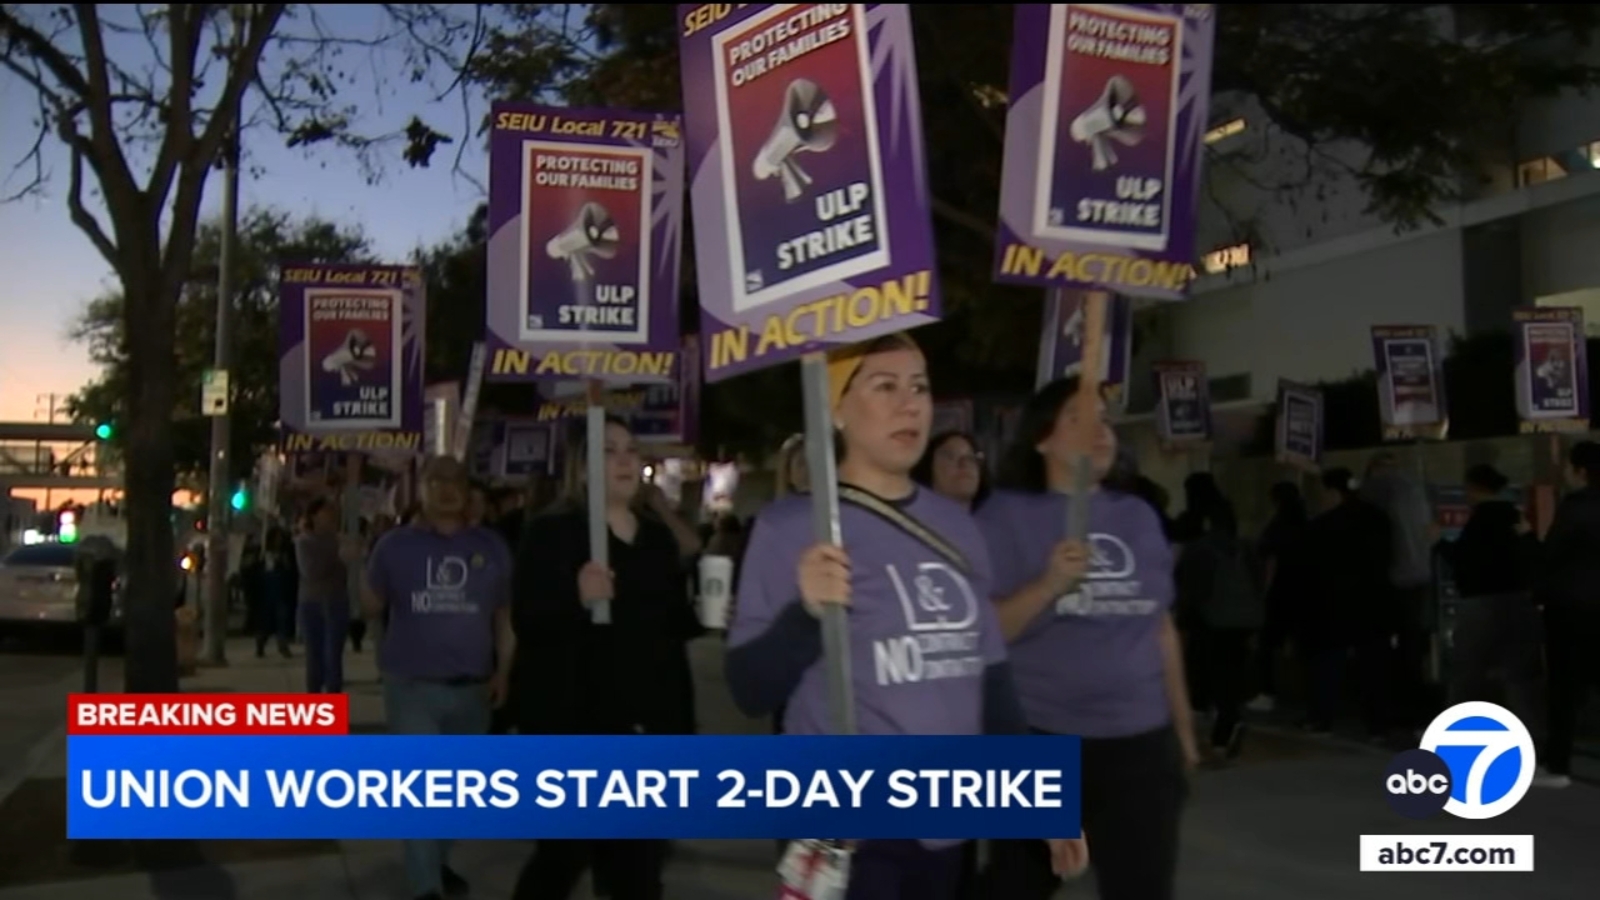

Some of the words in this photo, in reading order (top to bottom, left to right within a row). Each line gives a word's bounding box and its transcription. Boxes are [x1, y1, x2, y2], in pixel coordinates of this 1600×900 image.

[730, 4, 848, 66] PROTECTING
[1068, 12, 1170, 46] PROTECTING
[732, 56, 768, 87] OUR
[766, 19, 850, 70] FAMILIES
[1068, 35, 1098, 54] OUR
[1098, 39, 1170, 66] FAMILIES
[496, 112, 547, 131] SEIU
[550, 117, 606, 137] Local
[610, 121, 647, 139] 721
[535, 155, 638, 175] PROTECTING
[535, 173, 568, 187] OUR
[570, 174, 638, 190] FAMILIES
[1115, 175, 1162, 200] ULP
[815, 182, 869, 222] ULP
[1077, 198, 1161, 227] STRIKE
[778, 215, 874, 271] STRIKE
[282, 268, 320, 284] SEIU
[325, 269, 366, 285] Local
[371, 270, 397, 285] 721
[1001, 243, 1043, 277] IN
[1047, 253, 1194, 291] ACTION!
[312, 298, 389, 311] PROTECTING
[596, 285, 635, 304] ULP
[313, 309, 337, 321] OUR
[338, 309, 389, 322] FAMILIES
[558, 305, 635, 326] STRIKE
[710, 325, 748, 369] IN
[755, 269, 932, 356] ACTION!
[492, 350, 530, 374] IN
[535, 351, 676, 376] ACTION!
[359, 387, 388, 401] ULP
[332, 403, 389, 417] STRIKE
[286, 432, 316, 450] IN
[319, 432, 421, 450] ACTION!
[873, 635, 924, 686] NO
